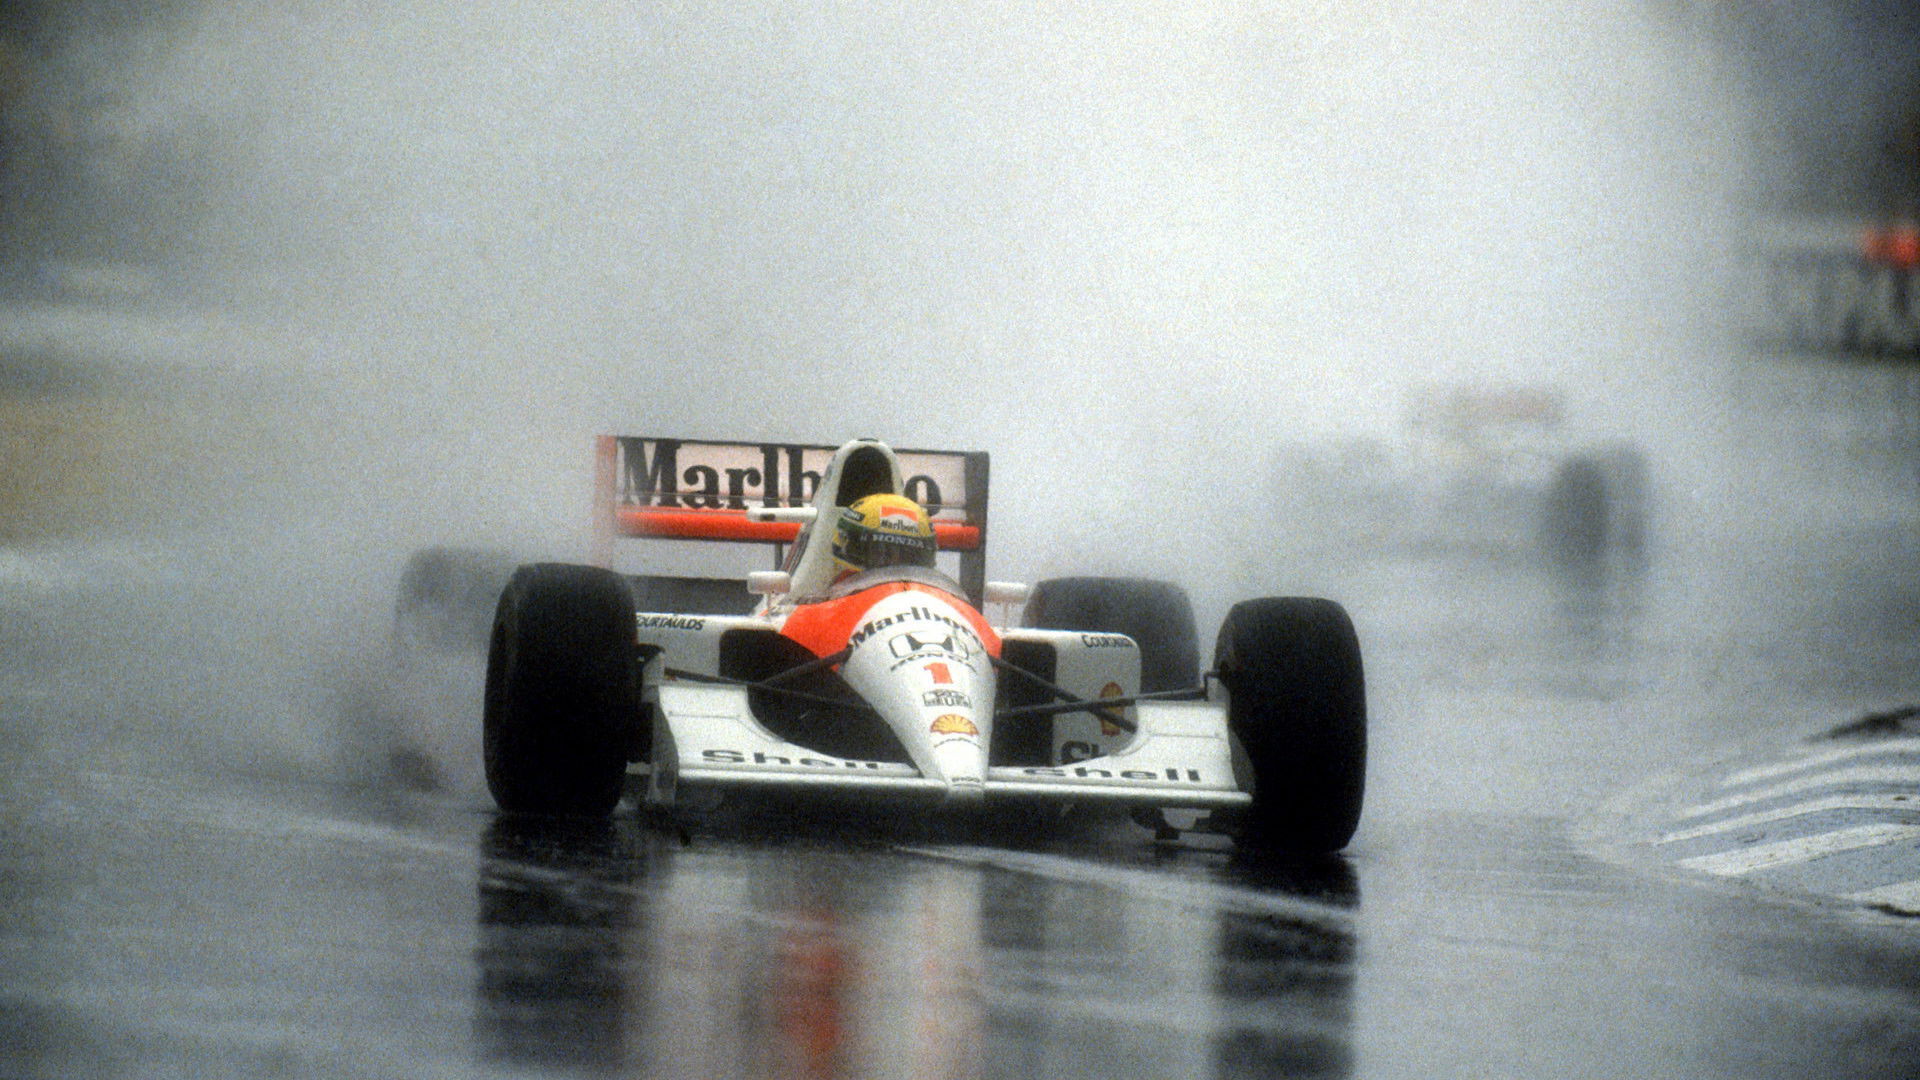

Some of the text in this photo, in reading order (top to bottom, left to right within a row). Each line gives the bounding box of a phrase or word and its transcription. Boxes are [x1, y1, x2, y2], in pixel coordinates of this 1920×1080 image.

[620, 438, 942, 518] Marlbo
[872, 534, 925, 549] HONDA
[923, 662, 954, 684] 1
